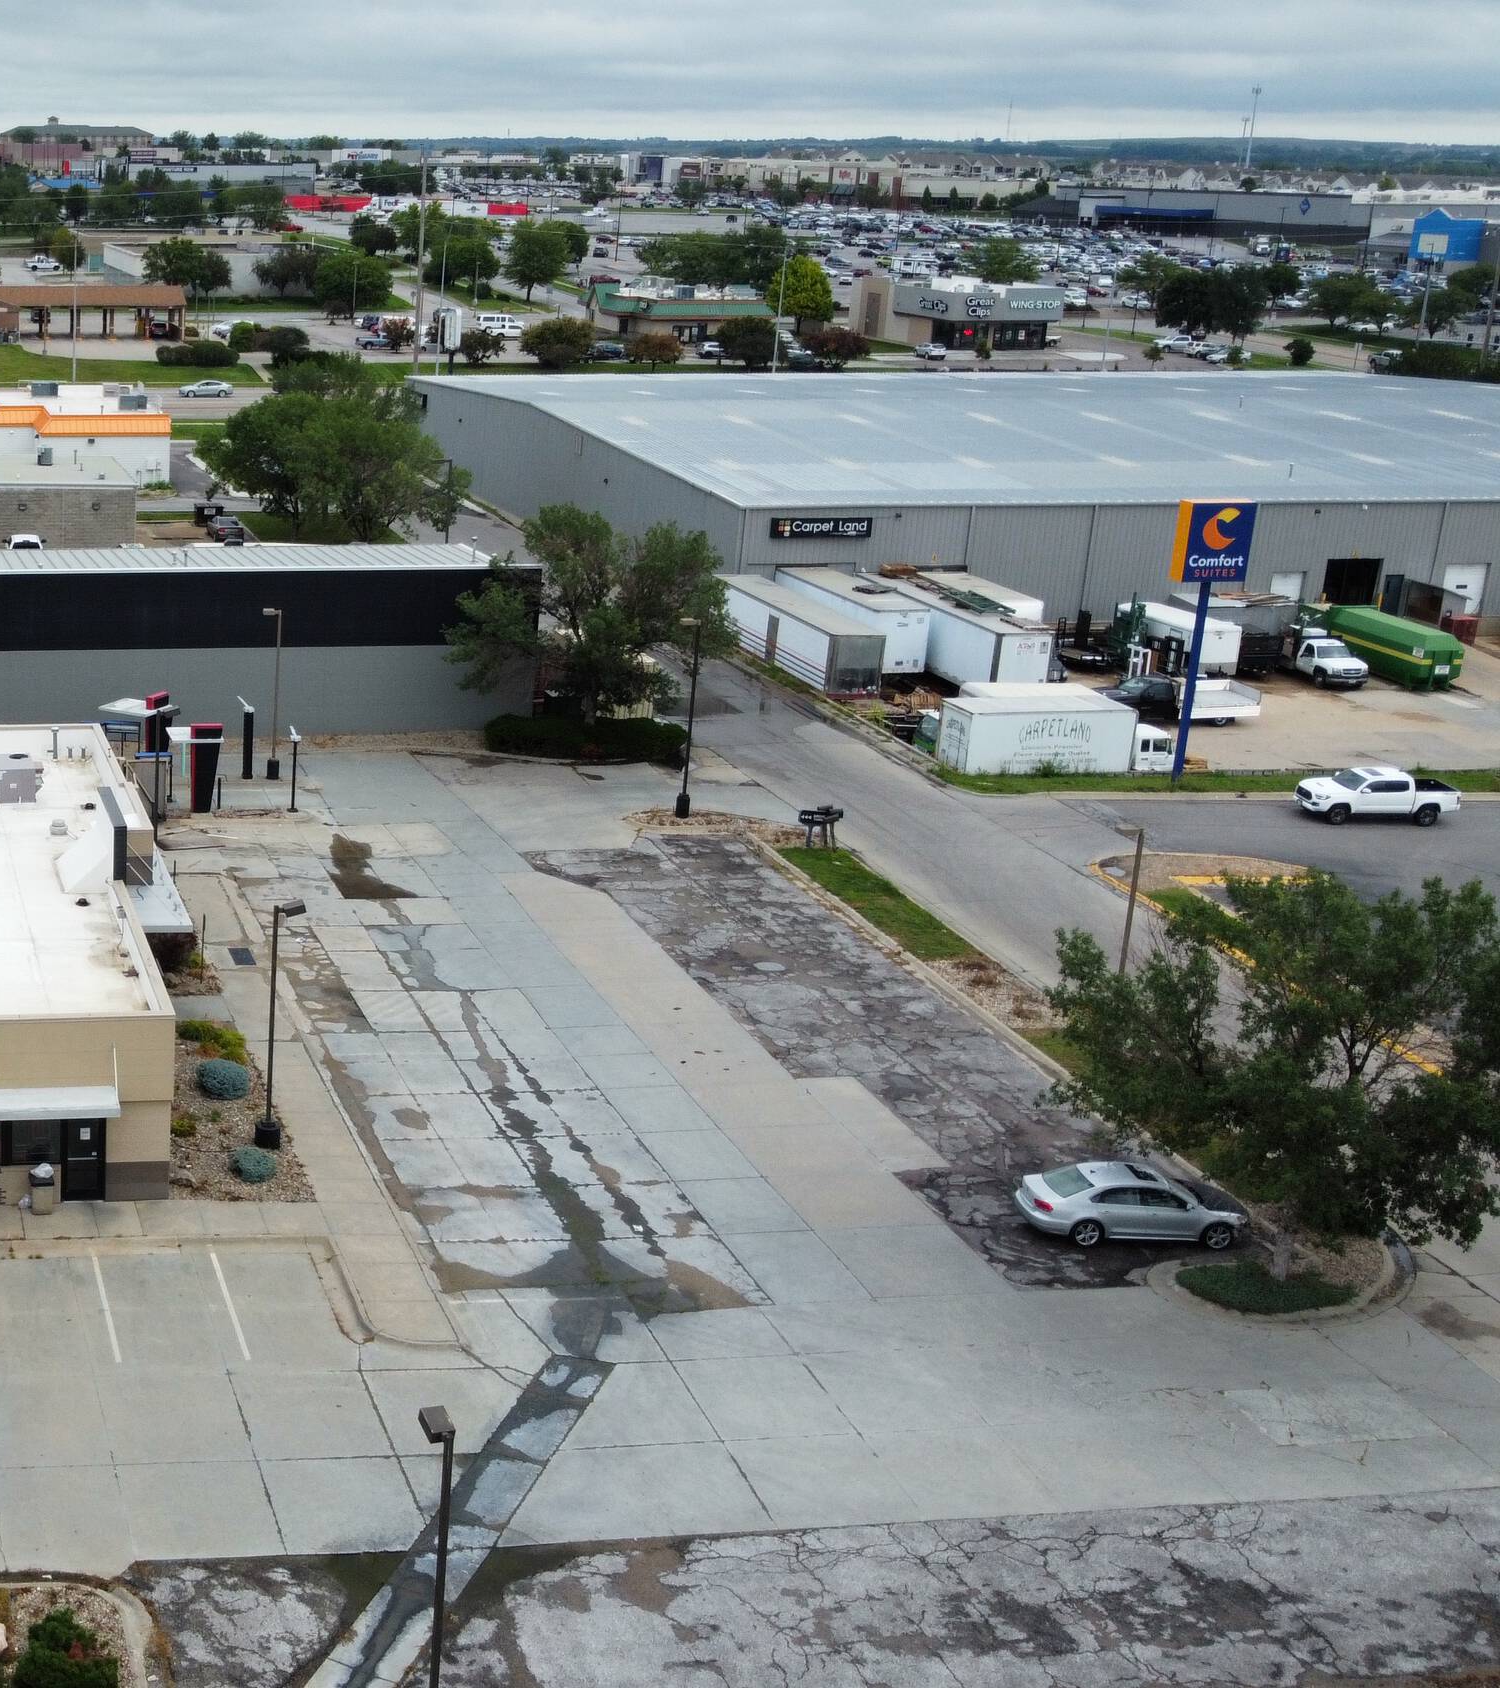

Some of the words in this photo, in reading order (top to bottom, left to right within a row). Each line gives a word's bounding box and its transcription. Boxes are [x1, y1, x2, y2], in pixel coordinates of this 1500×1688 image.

[966, 297, 995, 306] Great
[968, 307, 991, 318] Clips
[792, 520, 834, 533] Carpet
[838, 520, 868, 532] Land
[1189, 554, 1244, 567] Comfort
[1194, 569, 1236, 577] SUITES
[1019, 718, 1091, 743] CARPETLAND
